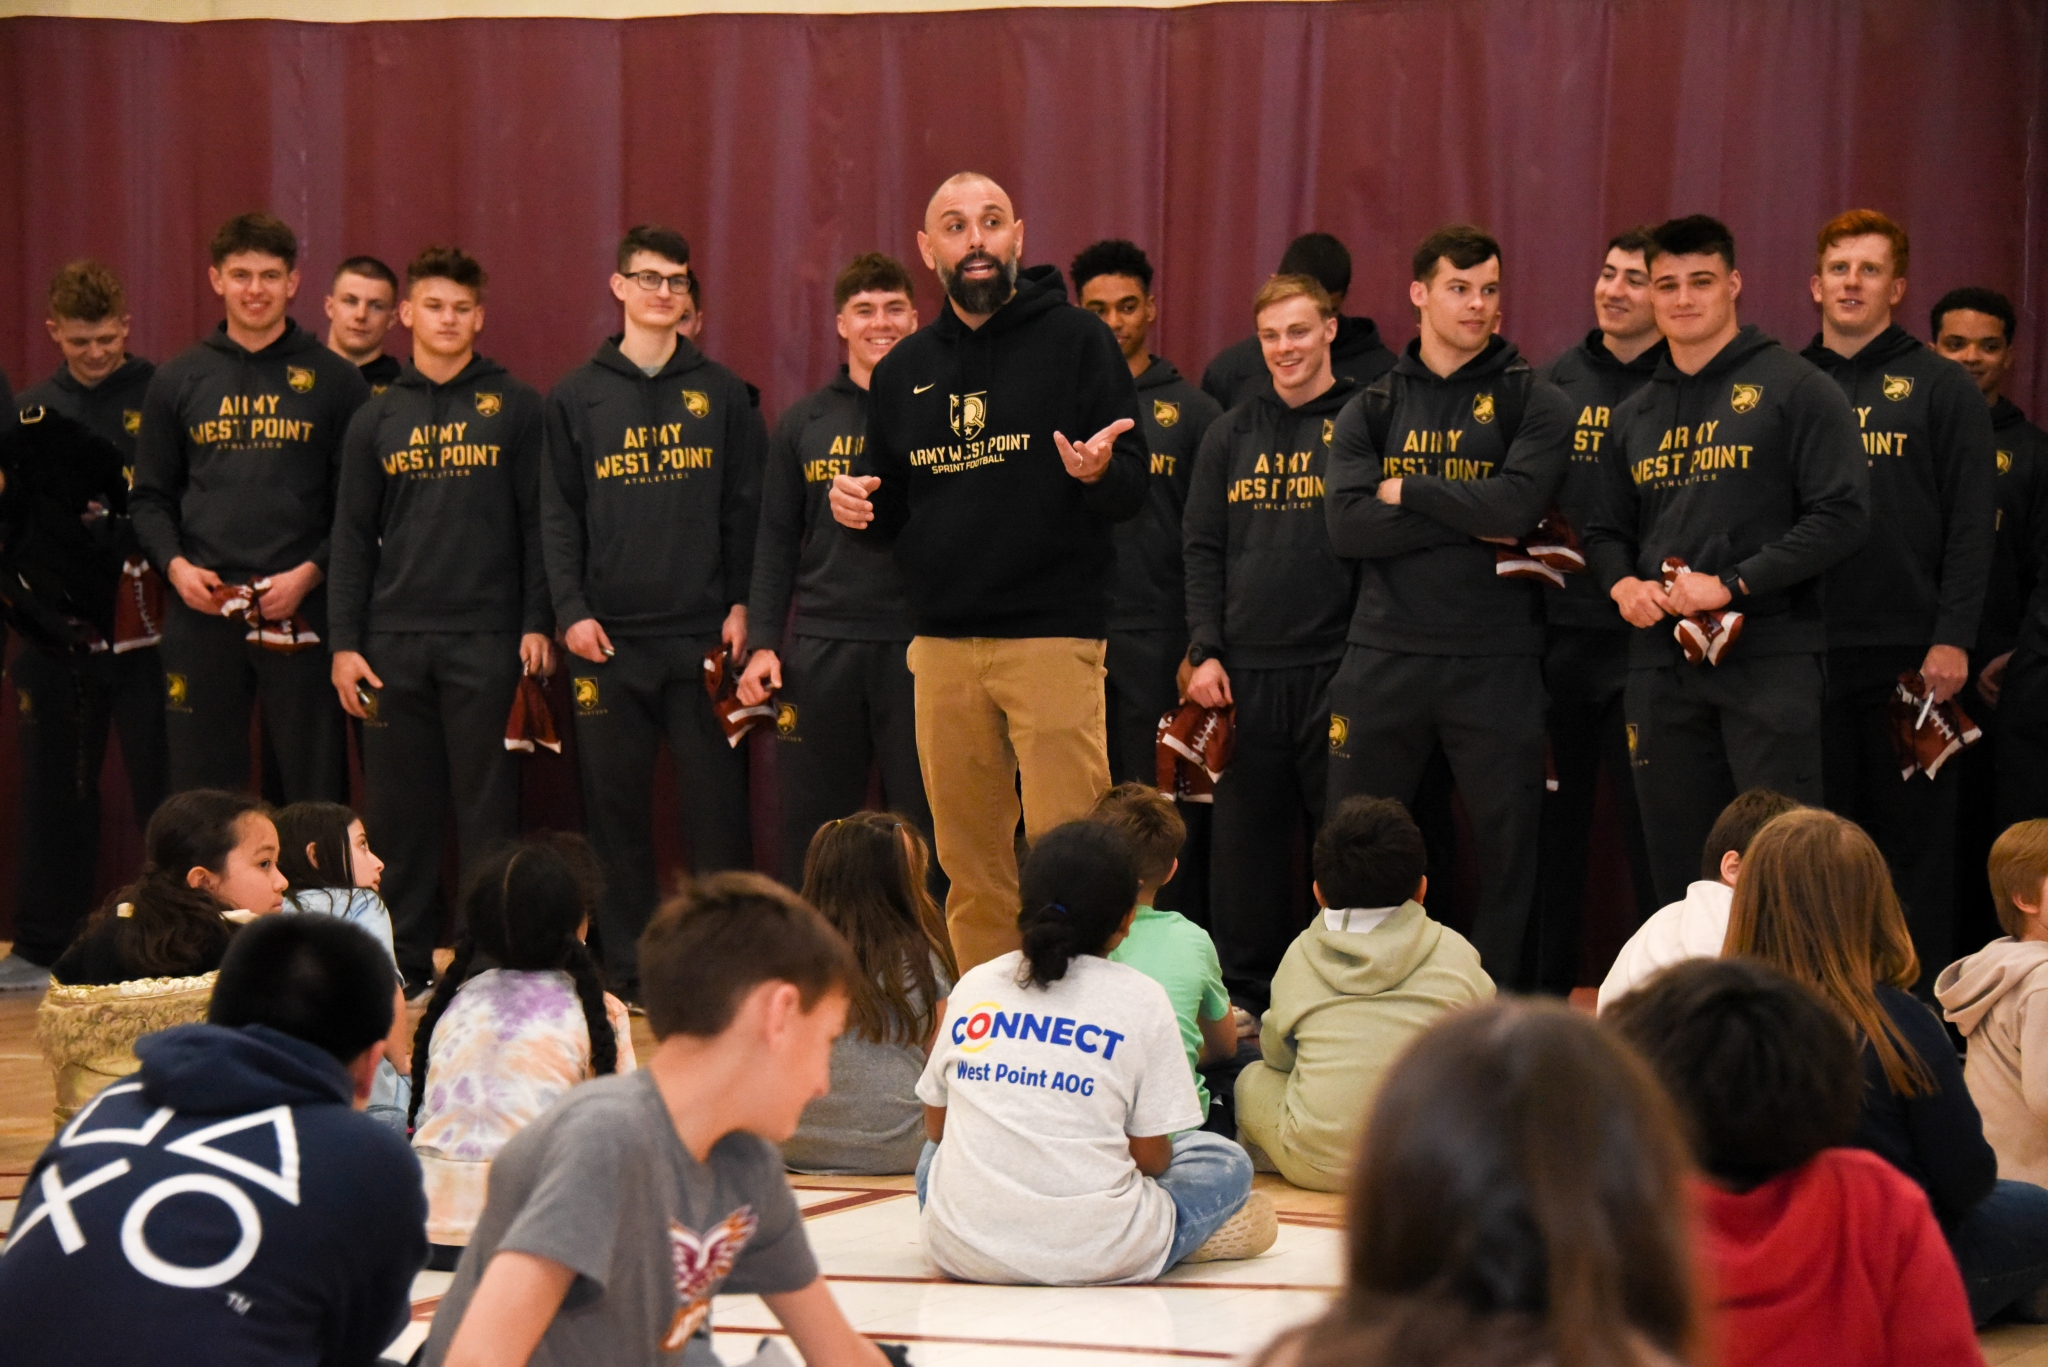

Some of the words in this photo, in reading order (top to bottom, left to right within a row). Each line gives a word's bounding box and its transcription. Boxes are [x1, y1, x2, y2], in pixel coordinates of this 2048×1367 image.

[1577, 405, 1611, 428] AR
[251, 418, 314, 442] POINT
[1573, 429, 1605, 452] ST
[440, 444, 501, 469] POINT
[909, 446, 946, 466] ARMY
[987, 434, 1031, 454] POINT
[1861, 431, 1908, 457] INT
[595, 452, 650, 479] WEST
[658, 446, 714, 472] POINT
[931, 462, 965, 475] SPRINT
[965, 453, 1005, 471] FOOTBALL
[1442, 457, 1494, 481] OINT
[1631, 453, 1685, 485] WEST
[1688, 445, 1753, 474] POINT
[1227, 478, 1281, 504] WEST
[1286, 476, 1324, 500] POIN
[951, 1011, 1125, 1061] CONNECT
[957, 1060, 991, 1081] West
[995, 1063, 1048, 1088] Point
[1051, 1071, 1095, 1097] AOG
